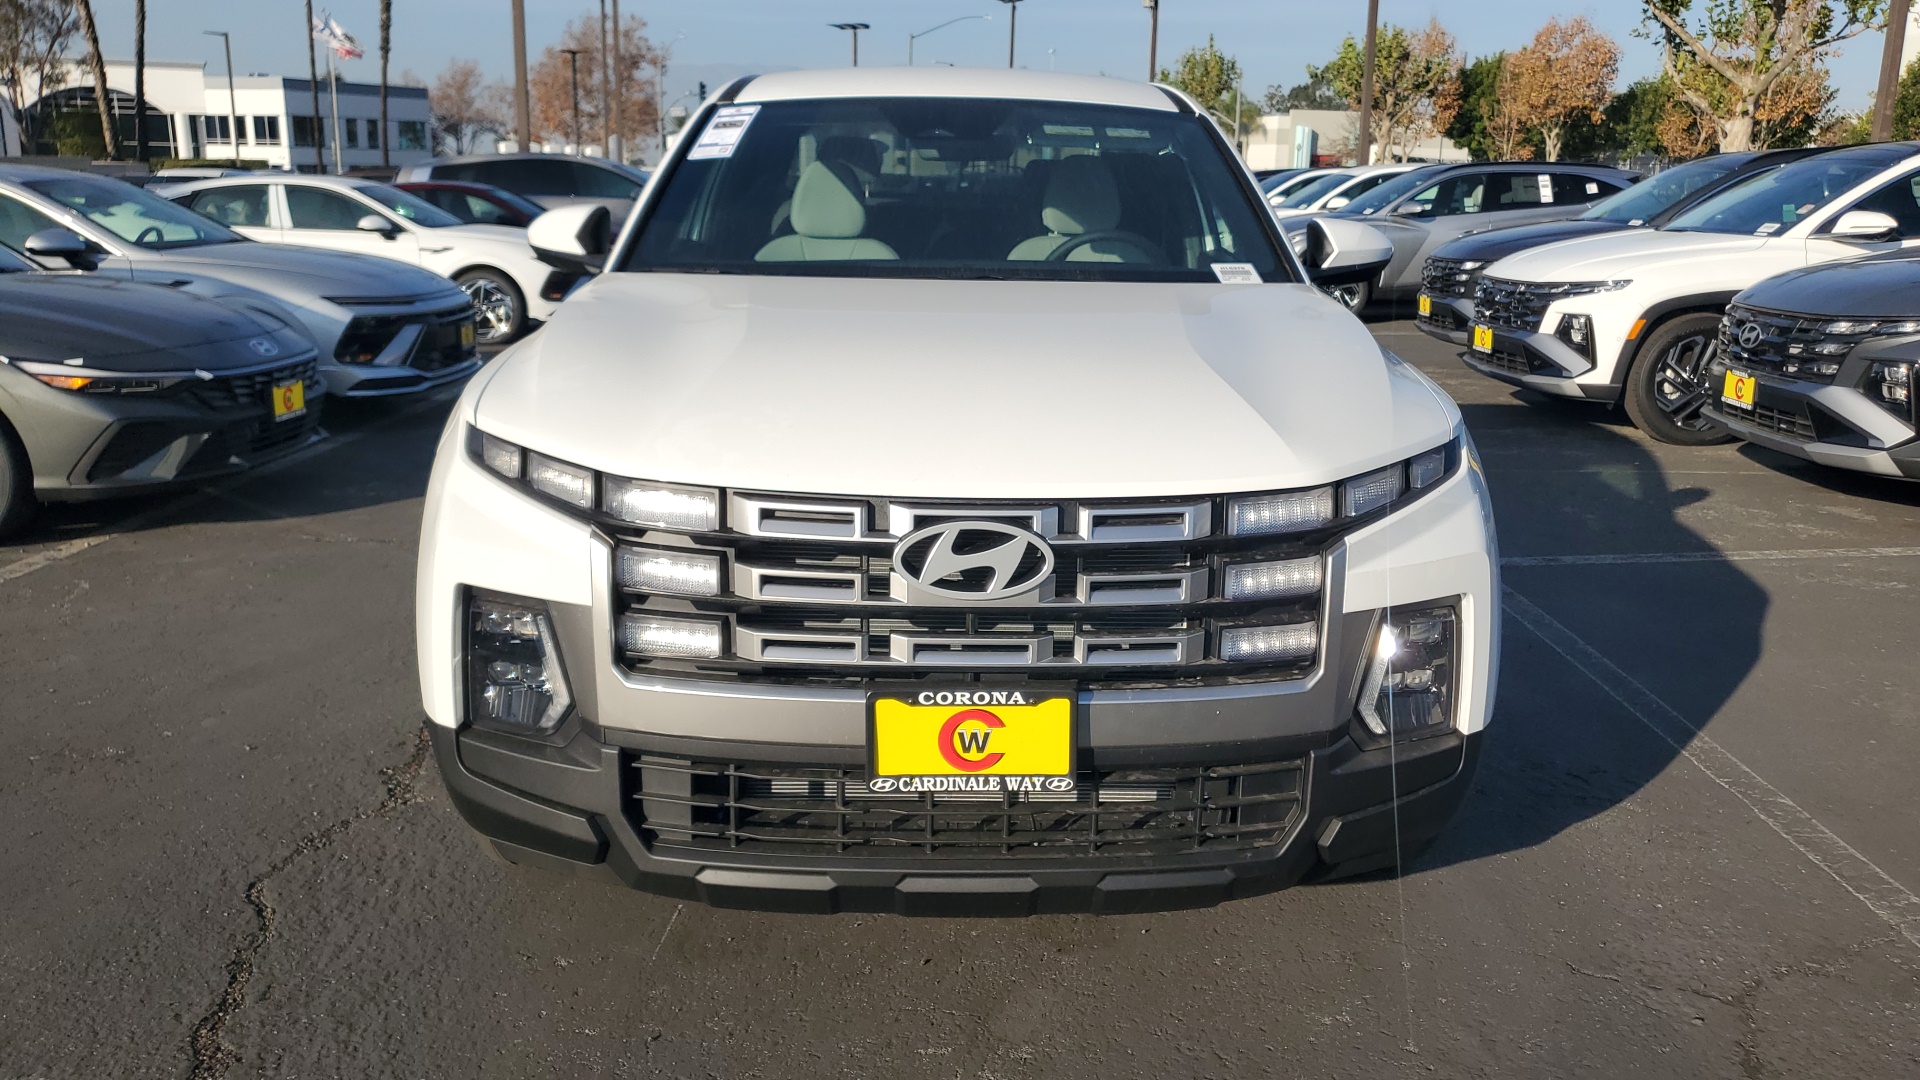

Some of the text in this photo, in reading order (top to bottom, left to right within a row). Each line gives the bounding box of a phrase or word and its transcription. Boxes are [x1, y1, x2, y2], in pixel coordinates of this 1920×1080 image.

[918, 691, 1026, 705] CORONA
[938, 708, 1006, 772] C
[957, 728, 993, 754] W
[898, 776, 1045, 791] CARDINALE WAY
